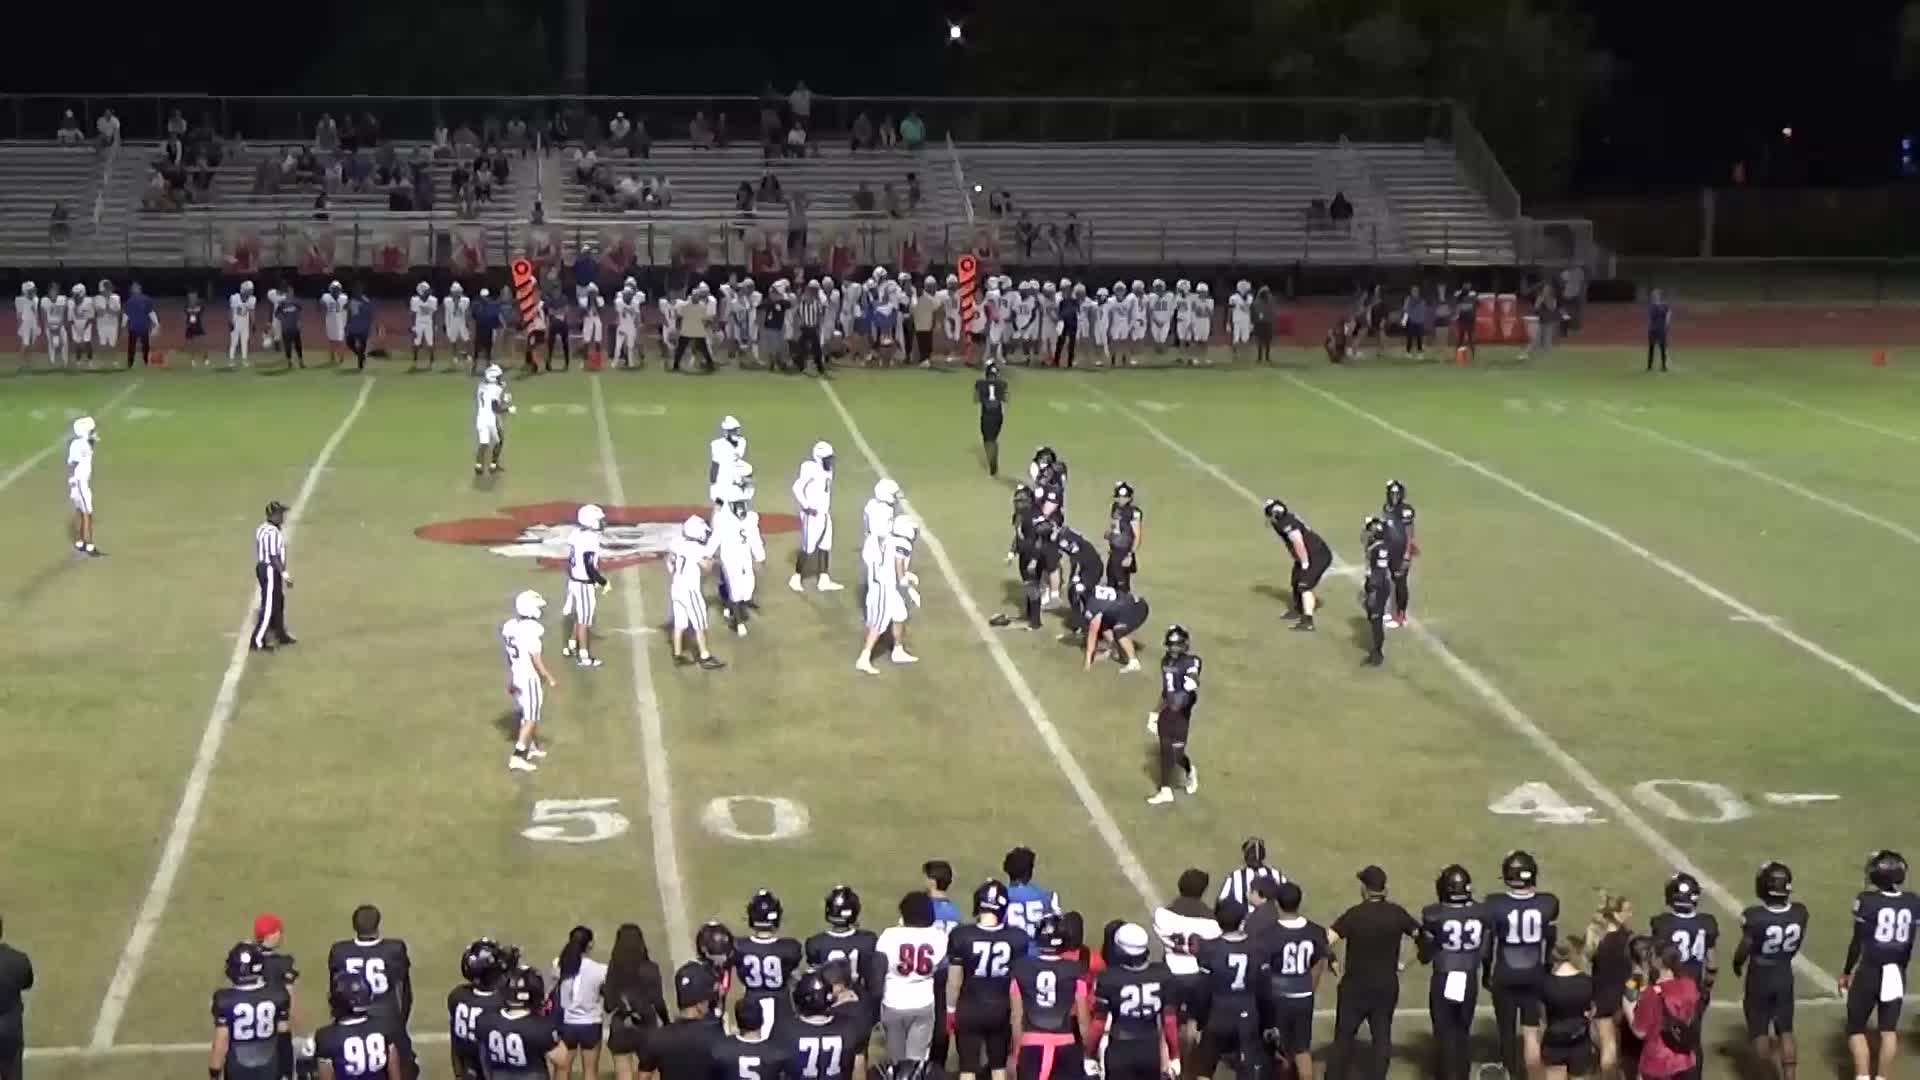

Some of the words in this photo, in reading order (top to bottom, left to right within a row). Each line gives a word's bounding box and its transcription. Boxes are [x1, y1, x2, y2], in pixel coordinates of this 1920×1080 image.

[988, 384, 996, 401] 1
[1442, 920, 1482, 950] 33
[1507, 909, 1542, 944] 10
[1762, 923, 1801, 954] 22
[1874, 907, 1912, 942] 88
[898, 943, 934, 977] 96
[973, 941, 1011, 977] 72
[1281, 940, 1313, 975] 60
[1672, 929, 1706, 962] 34
[743, 955, 783, 988] 39
[1036, 970, 1057, 1007] 9
[1228, 953, 1248, 992] 7
[1120, 982, 1161, 1016] 25
[233, 1001, 276, 1040] 28
[343, 1033, 387, 1075] 98
[488, 1031, 527, 1066] 99
[799, 1036, 842, 1077] 77
[738, 1056, 761, 1080] 5
